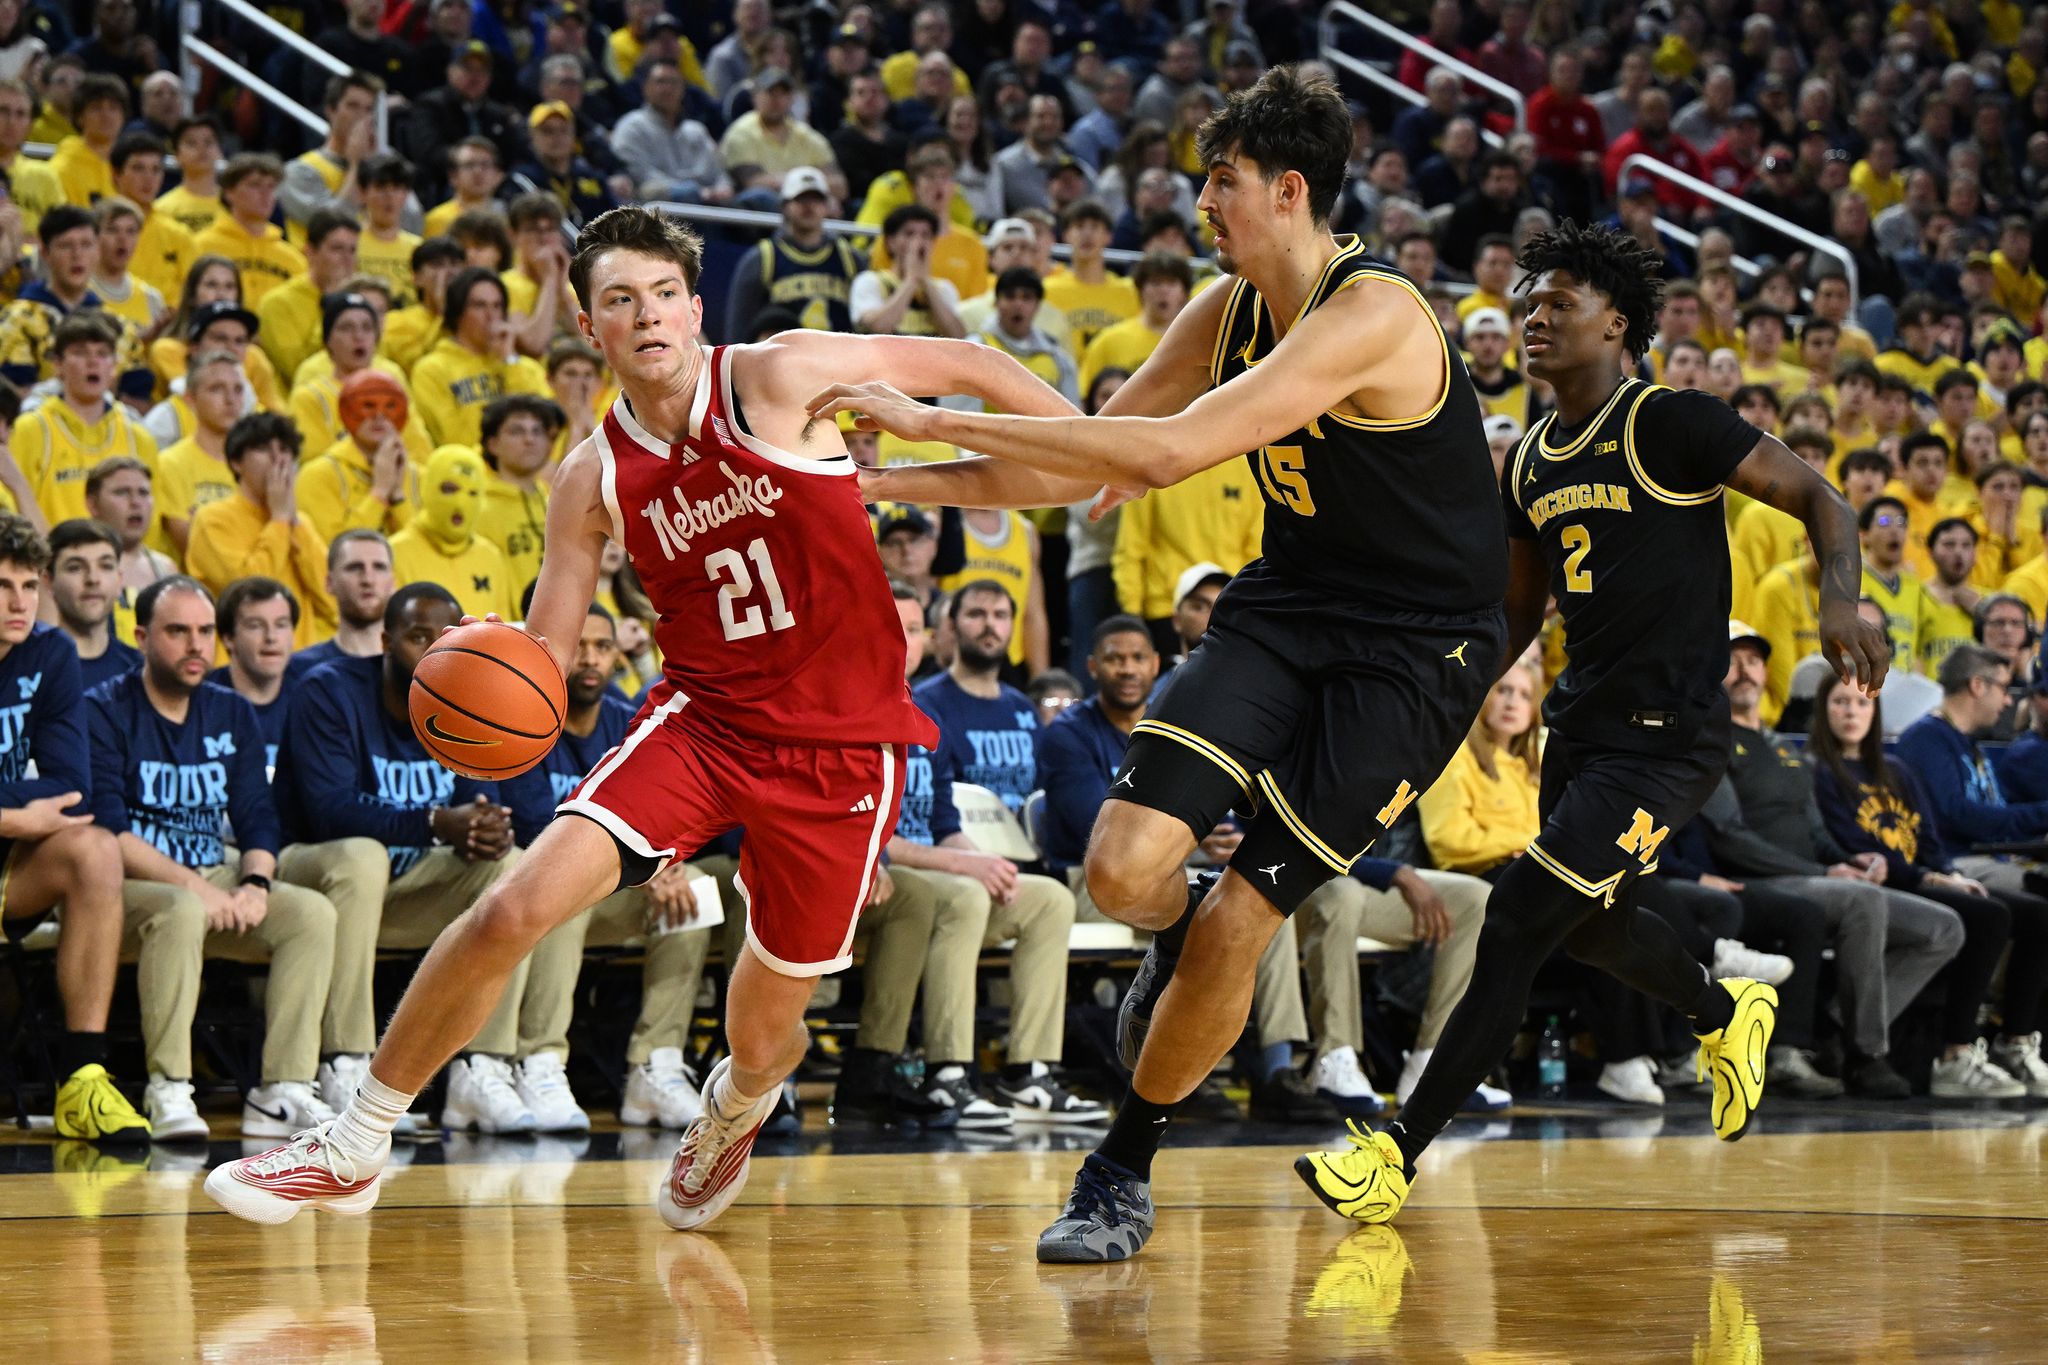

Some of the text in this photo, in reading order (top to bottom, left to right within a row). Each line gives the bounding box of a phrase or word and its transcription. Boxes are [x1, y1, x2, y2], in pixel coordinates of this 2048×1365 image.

[1258, 446, 1316, 517] 15
[640, 460, 783, 561] Nebraska
[1527, 483, 1632, 532] MICHIGAN
[1561, 524, 1593, 593] 2
[705, 537, 796, 642] 21
[203, 732, 237, 758] M
[966, 730, 1034, 767] YOUR
[140, 761, 229, 808] YOUR
[372, 755, 456, 804] YOUR
[1375, 779, 1418, 829] M
[1616, 807, 1670, 865] M
